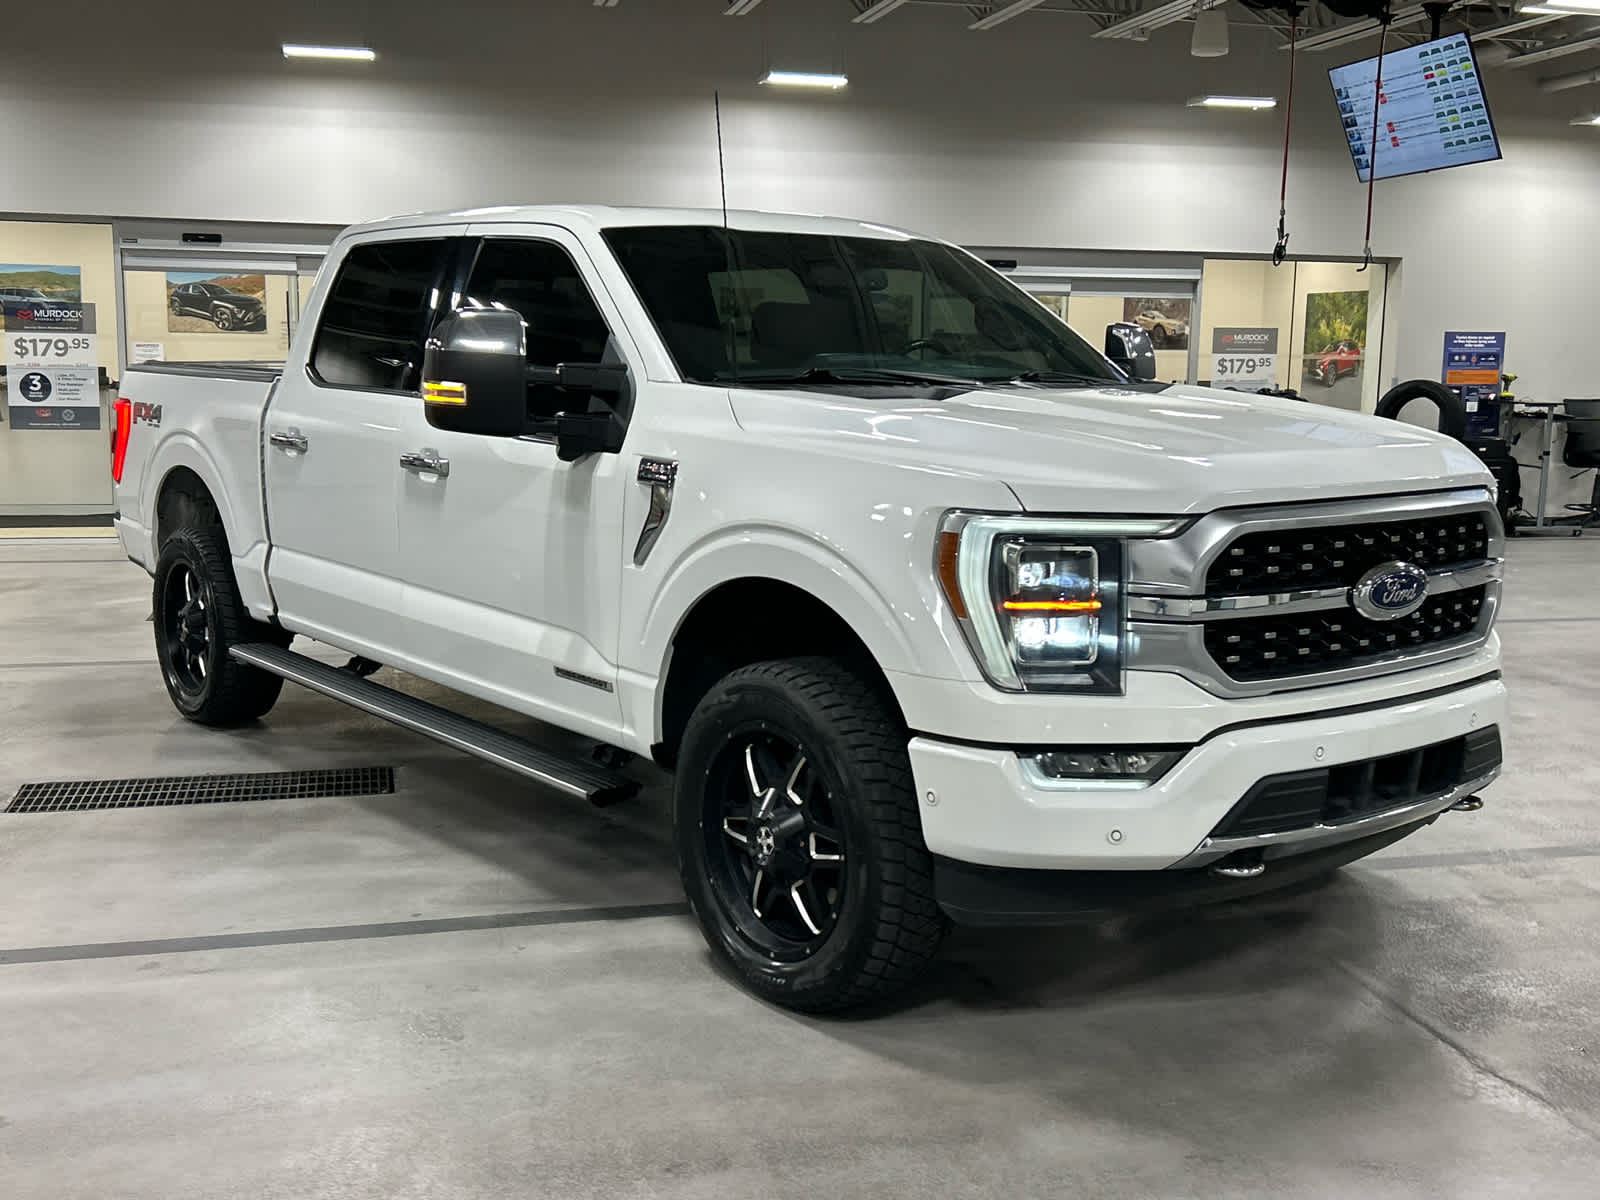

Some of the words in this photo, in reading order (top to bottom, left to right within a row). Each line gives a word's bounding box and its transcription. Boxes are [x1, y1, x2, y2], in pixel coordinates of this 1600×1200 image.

[34, 309, 84, 318] MURDOCK
[14, 337, 90, 358] $179.95
[28, 375, 42, 391] 3
[133, 402, 162, 424] FX4
[1383, 578, 1418, 604] Ford
